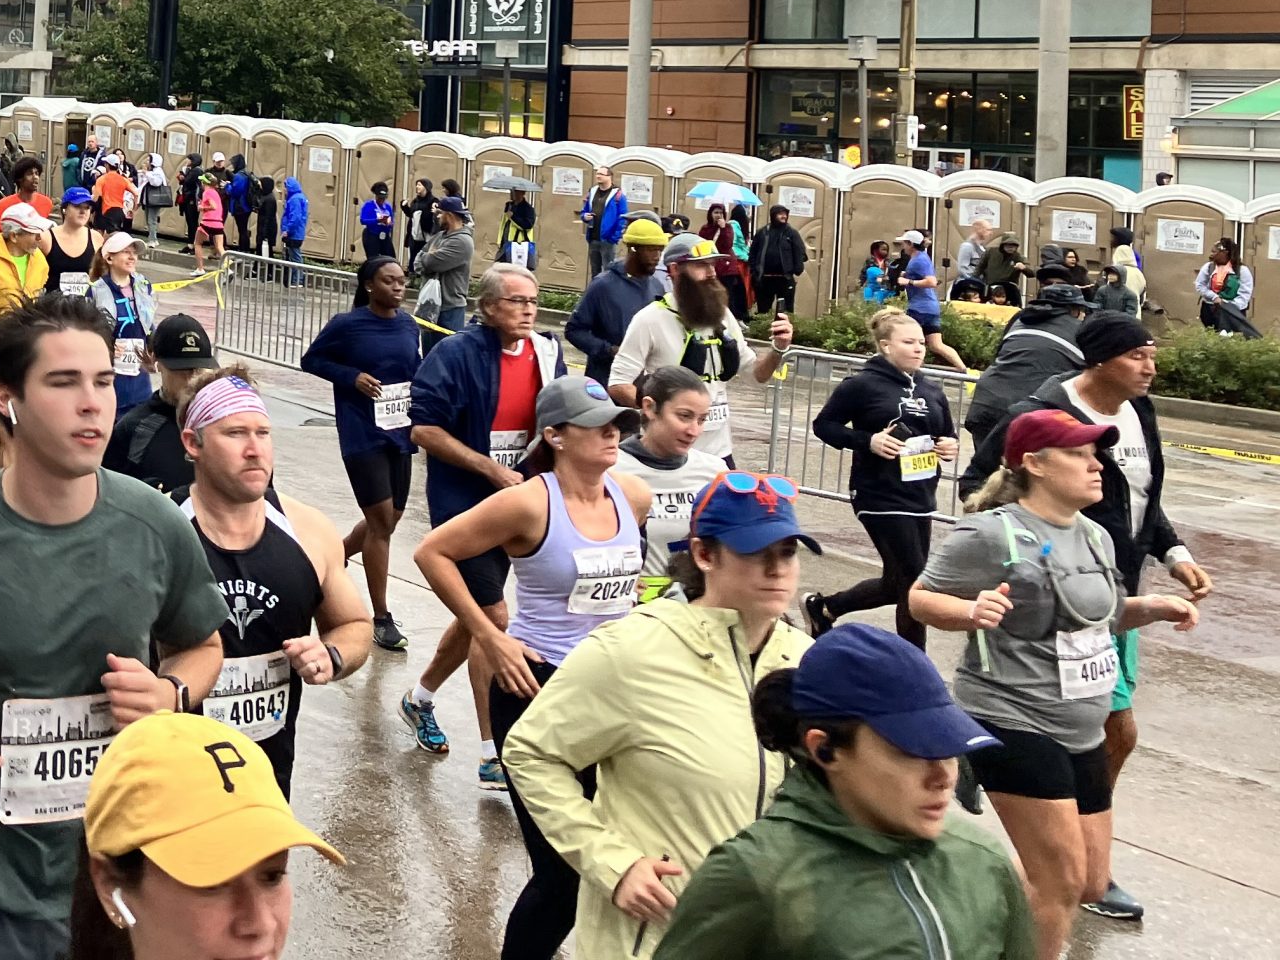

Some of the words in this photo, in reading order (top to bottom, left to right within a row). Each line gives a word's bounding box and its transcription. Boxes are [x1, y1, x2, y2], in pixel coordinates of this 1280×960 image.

[1130, 87, 1145, 138] SALE
[704, 407, 727, 422] 0514
[218, 578, 280, 610] NIGHTS
[229, 690, 286, 726] 40643
[34, 745, 108, 781] 4065
[204, 741, 246, 793] P
